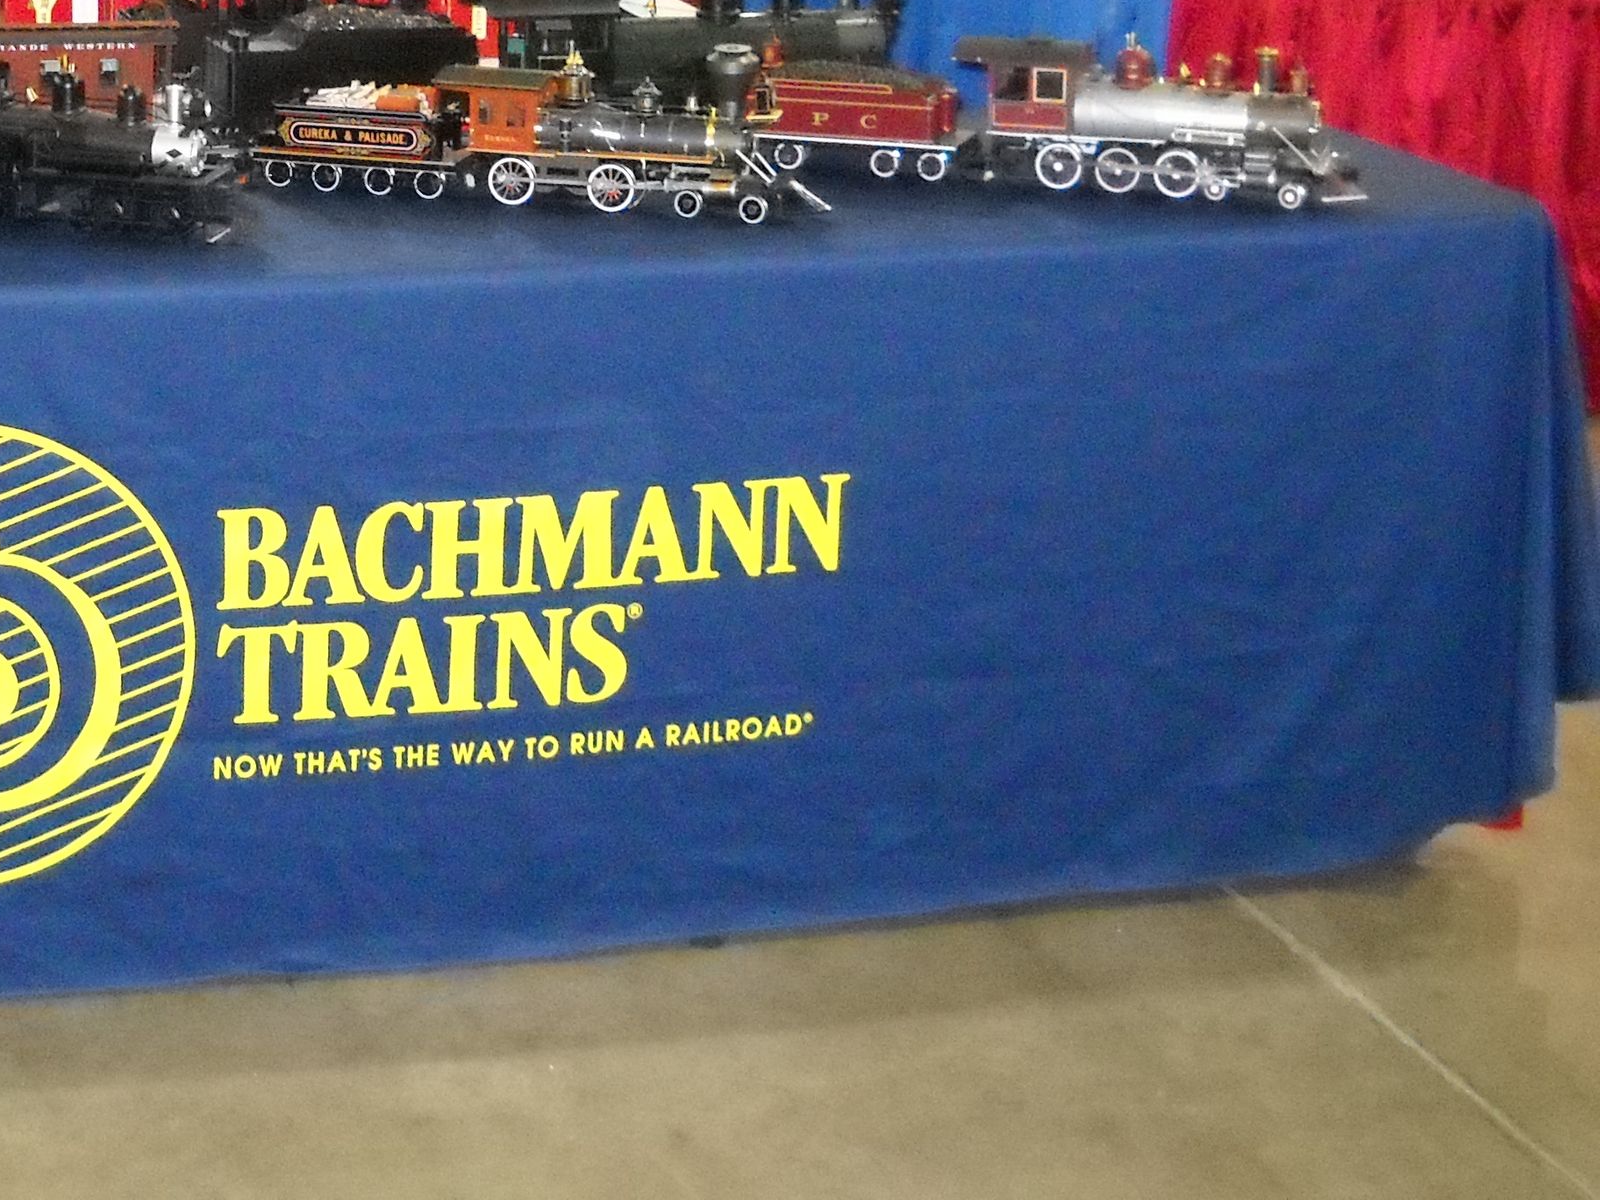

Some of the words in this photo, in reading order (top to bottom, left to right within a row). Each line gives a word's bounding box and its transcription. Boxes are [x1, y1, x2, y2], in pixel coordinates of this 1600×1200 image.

[299, 127, 337, 140] EUREKA
[344, 132, 352, 141] &
[358, 131, 406, 145] PALISADE
[812, 112, 829, 126] P
[860, 114, 877, 129] C
[216, 472, 851, 611] BACHMANN
[213, 754, 284, 780] NOW
[294, 747, 383, 775] THAT'S
[393, 743, 440, 768] THE
[451, 739, 515, 764] WAY
[525, 735, 560, 760] TO
[569, 730, 625, 756] RUN
[635, 727, 655, 749] A
